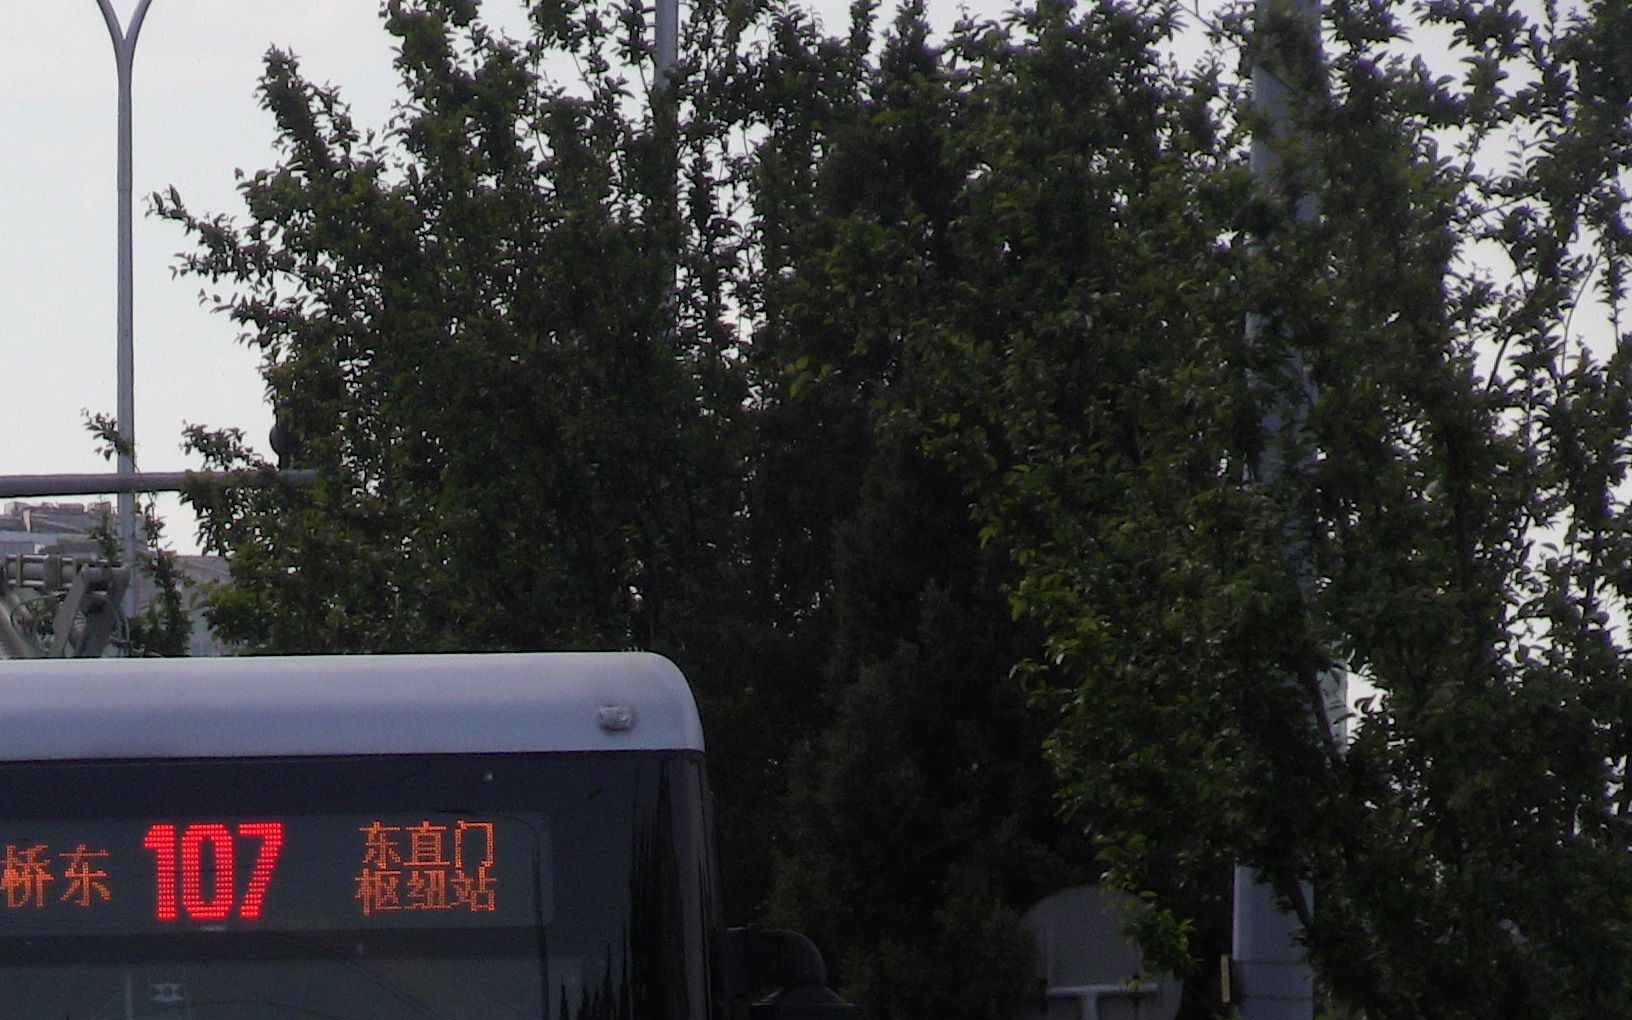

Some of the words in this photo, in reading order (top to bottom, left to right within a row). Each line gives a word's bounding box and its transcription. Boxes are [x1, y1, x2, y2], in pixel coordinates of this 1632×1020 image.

[356, 819, 497, 868] 东直门
[143, 821, 285, 920] 107
[353, 868, 499, 917] 枢纽站
